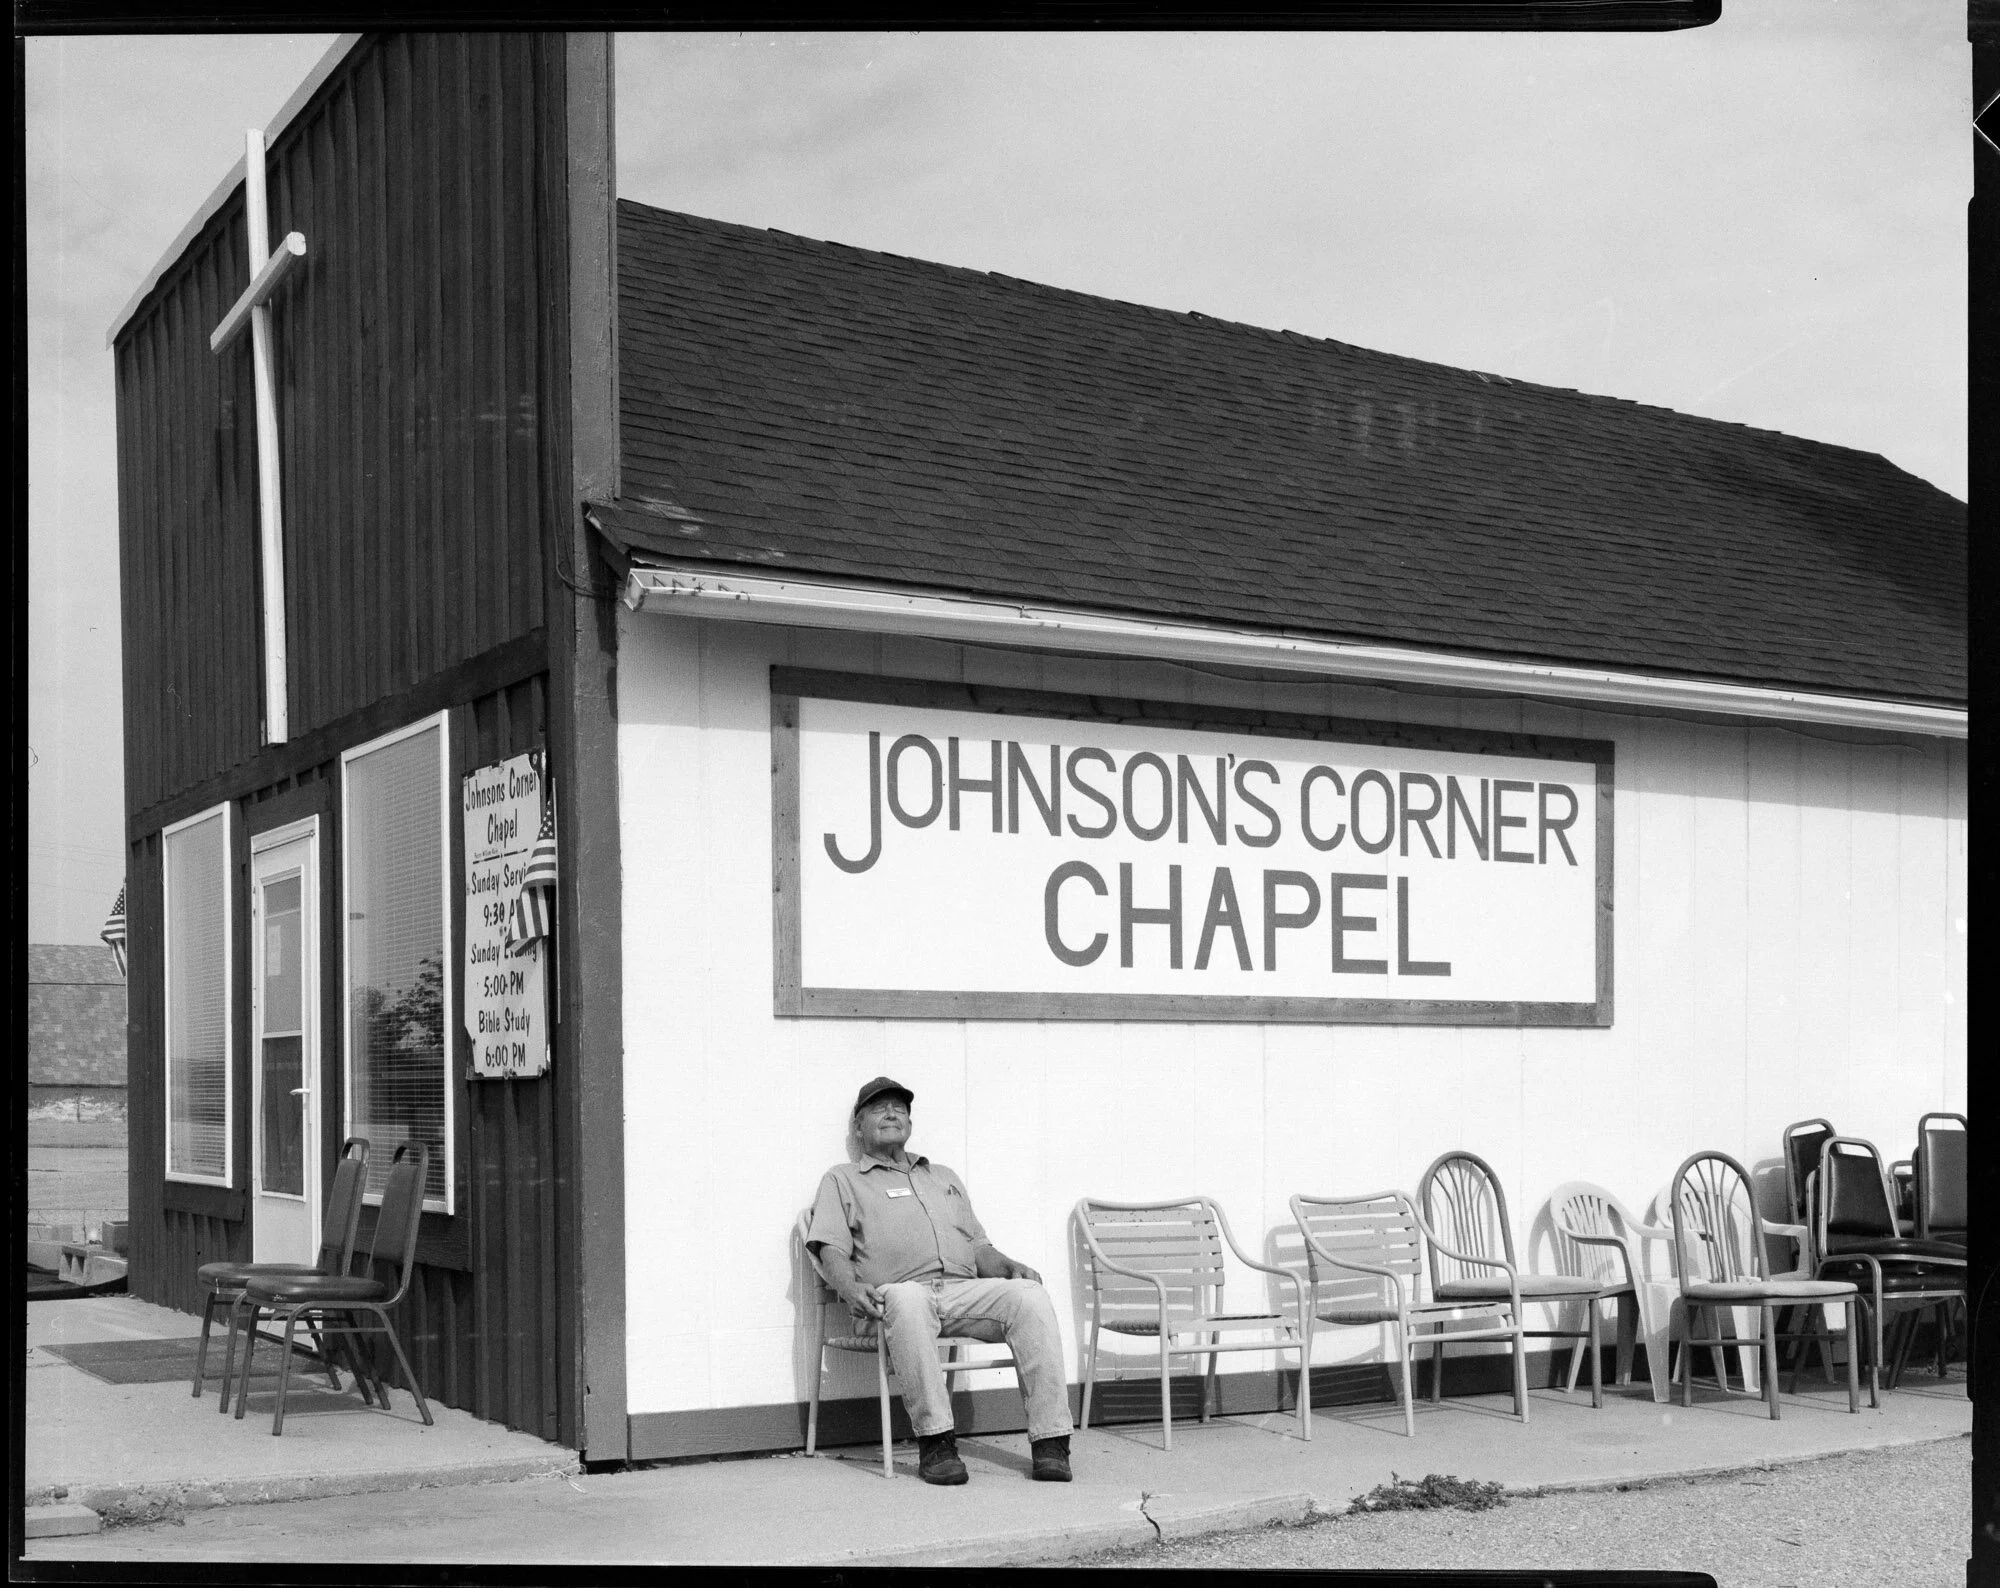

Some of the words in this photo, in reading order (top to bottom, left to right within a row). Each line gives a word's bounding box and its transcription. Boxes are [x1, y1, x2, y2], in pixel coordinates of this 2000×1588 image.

[465, 779, 505, 812] Johnsons
[823, 730, 1282, 874] JOHNSON'S
[1299, 764, 1580, 867] CORNER
[487, 808, 518, 849] Chapel
[471, 867, 500, 897] Sunday
[503, 862, 527, 888] Servi
[483, 901, 505, 928] 9:30
[1043, 860, 1452, 977] CHAPEL
[470, 939, 500, 968] Sunday
[484, 973, 506, 998] 5:00
[510, 971, 524, 996] PM
[478, 1010, 501, 1034] Bible
[503, 1006, 531, 1037] Study
[485, 1044, 508, 1068] 6:00
[512, 1042, 526, 1068] PM
